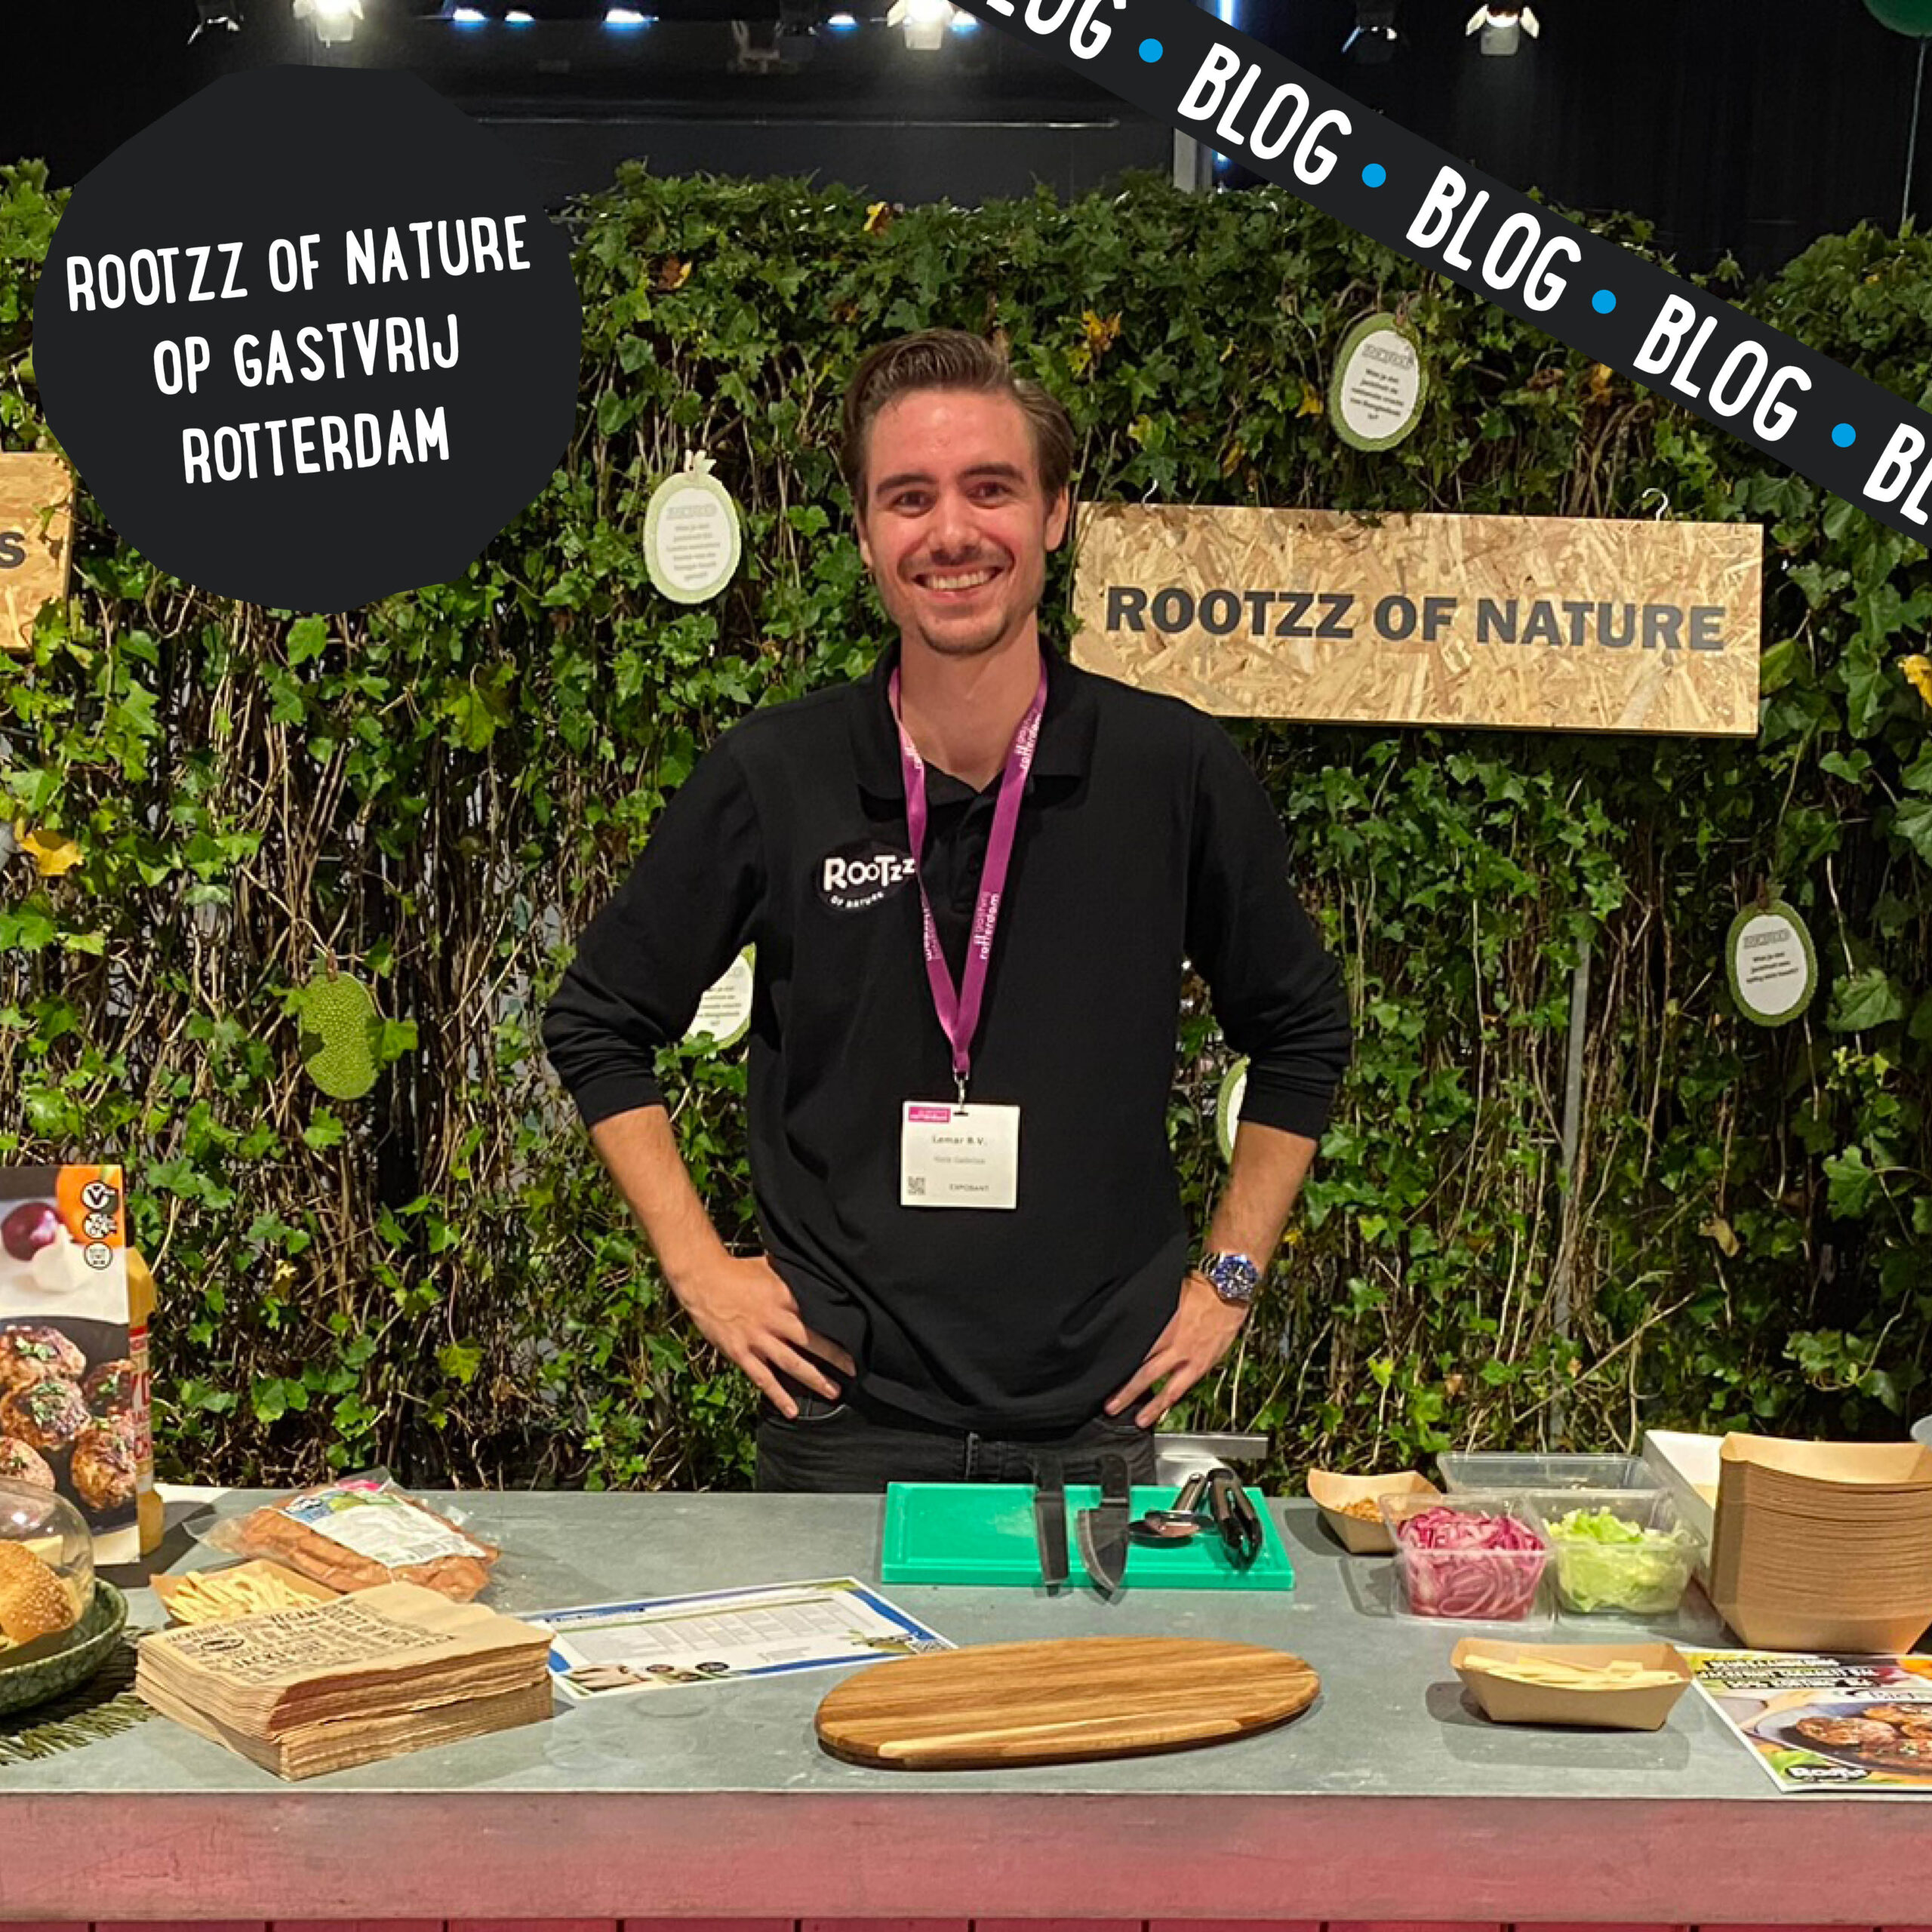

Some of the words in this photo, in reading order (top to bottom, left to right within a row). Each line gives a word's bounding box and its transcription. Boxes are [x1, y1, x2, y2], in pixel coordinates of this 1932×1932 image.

[1107, 587, 1354, 638] ROOTZZ
[1374, 595, 1457, 641] OF
[1478, 599, 1725, 651] NATURE
